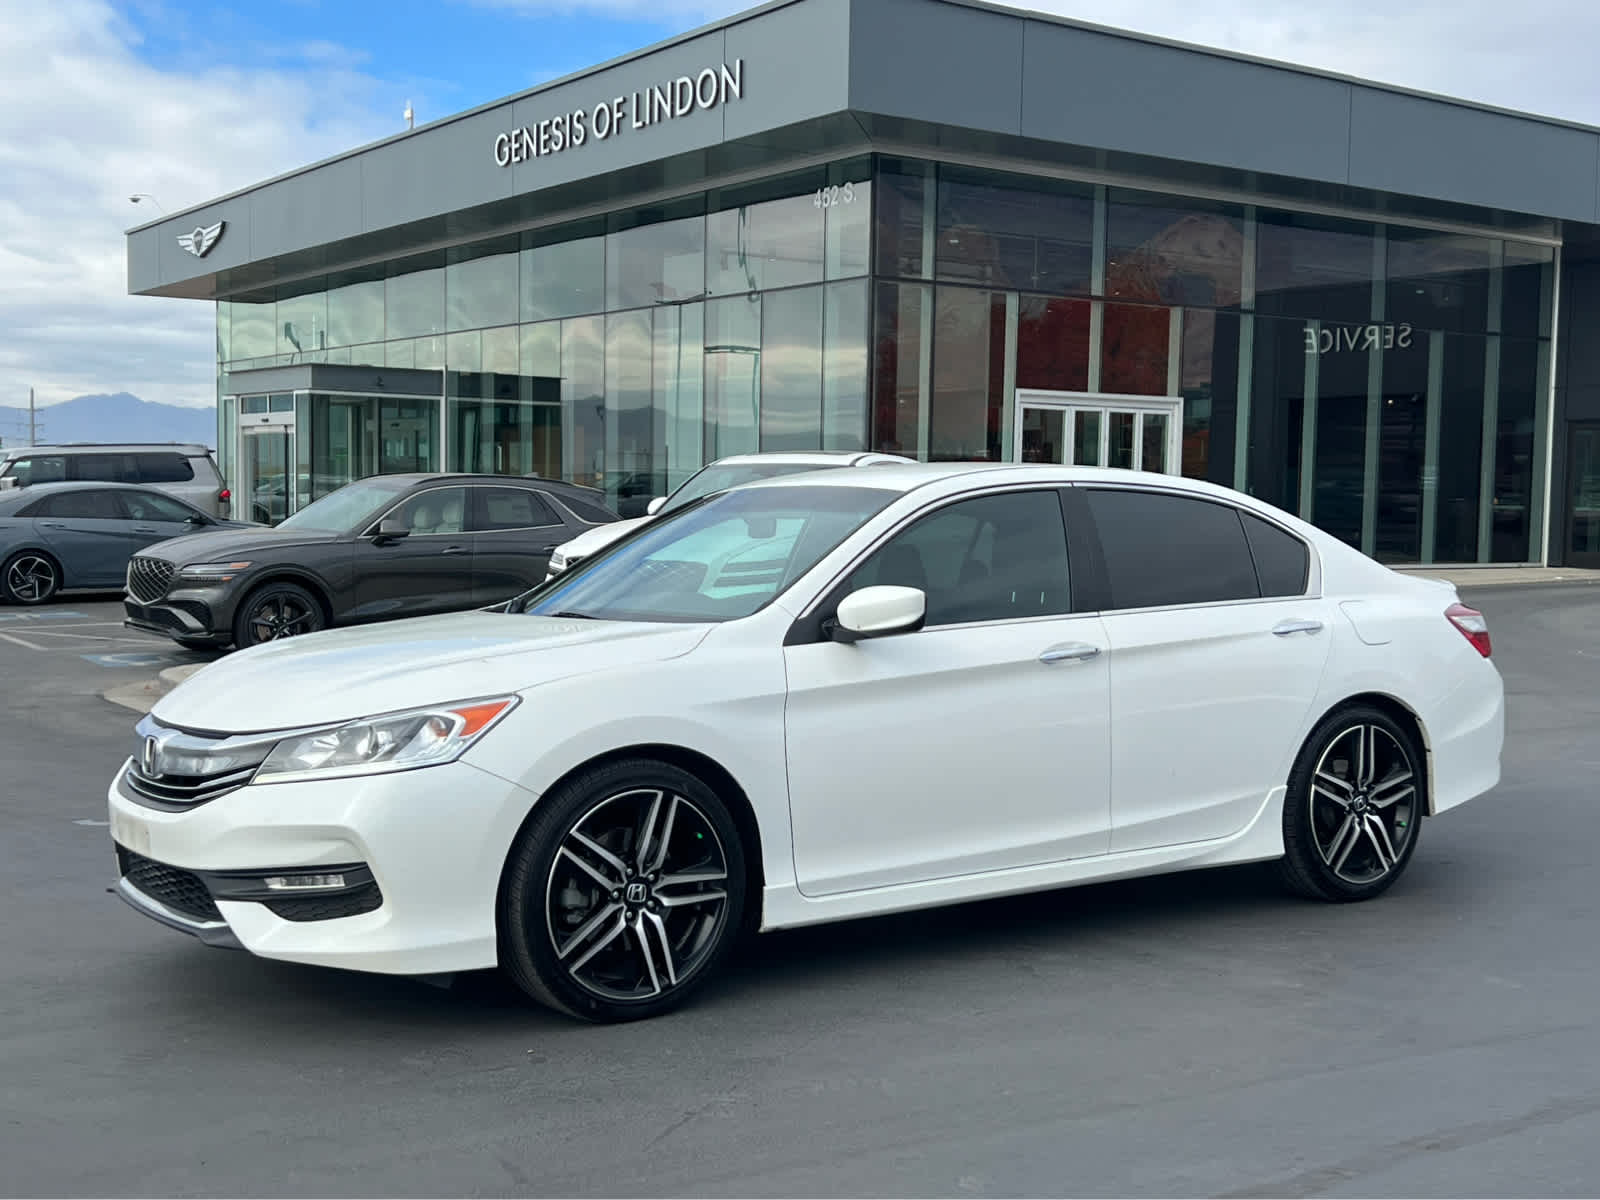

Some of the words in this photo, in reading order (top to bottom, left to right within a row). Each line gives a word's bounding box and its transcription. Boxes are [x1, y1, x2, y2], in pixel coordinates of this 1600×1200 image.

[494, 109, 586, 167] GENESIS
[592, 96, 626, 140] OF
[631, 58, 744, 129] LINDON
[813, 185, 839, 209] 452
[843, 182, 857, 204] S.
